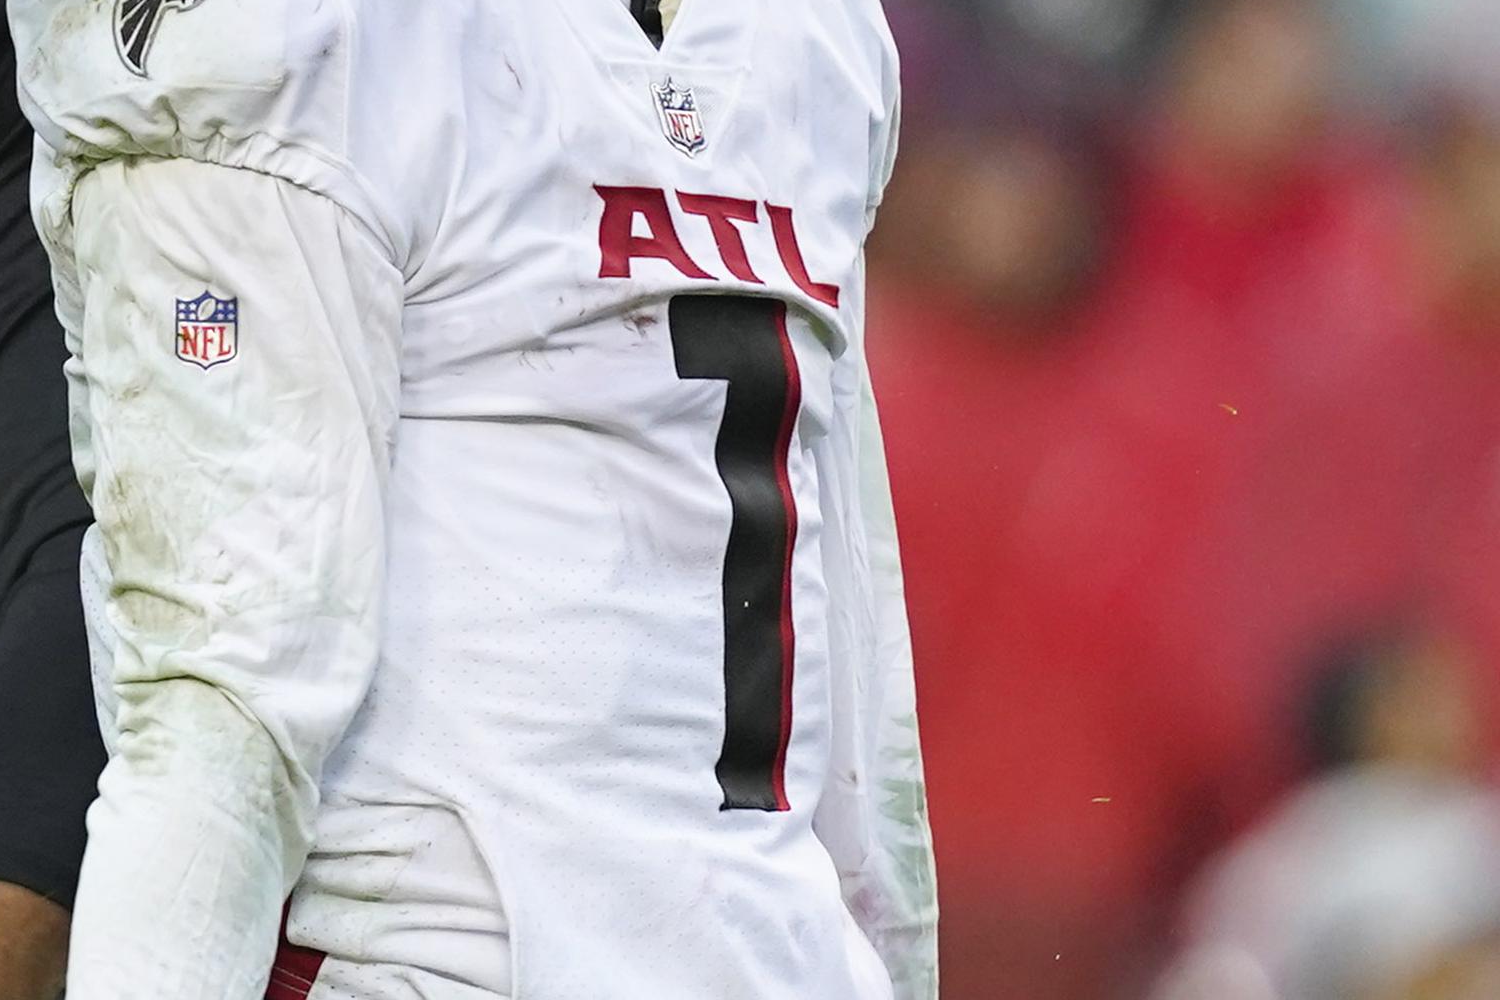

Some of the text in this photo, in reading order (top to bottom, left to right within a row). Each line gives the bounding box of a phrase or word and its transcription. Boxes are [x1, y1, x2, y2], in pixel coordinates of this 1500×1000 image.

[667, 111, 703, 144] NFL
[592, 184, 840, 309] ATL
[180, 325, 233, 361] NFL
[667, 294, 801, 812] 1
